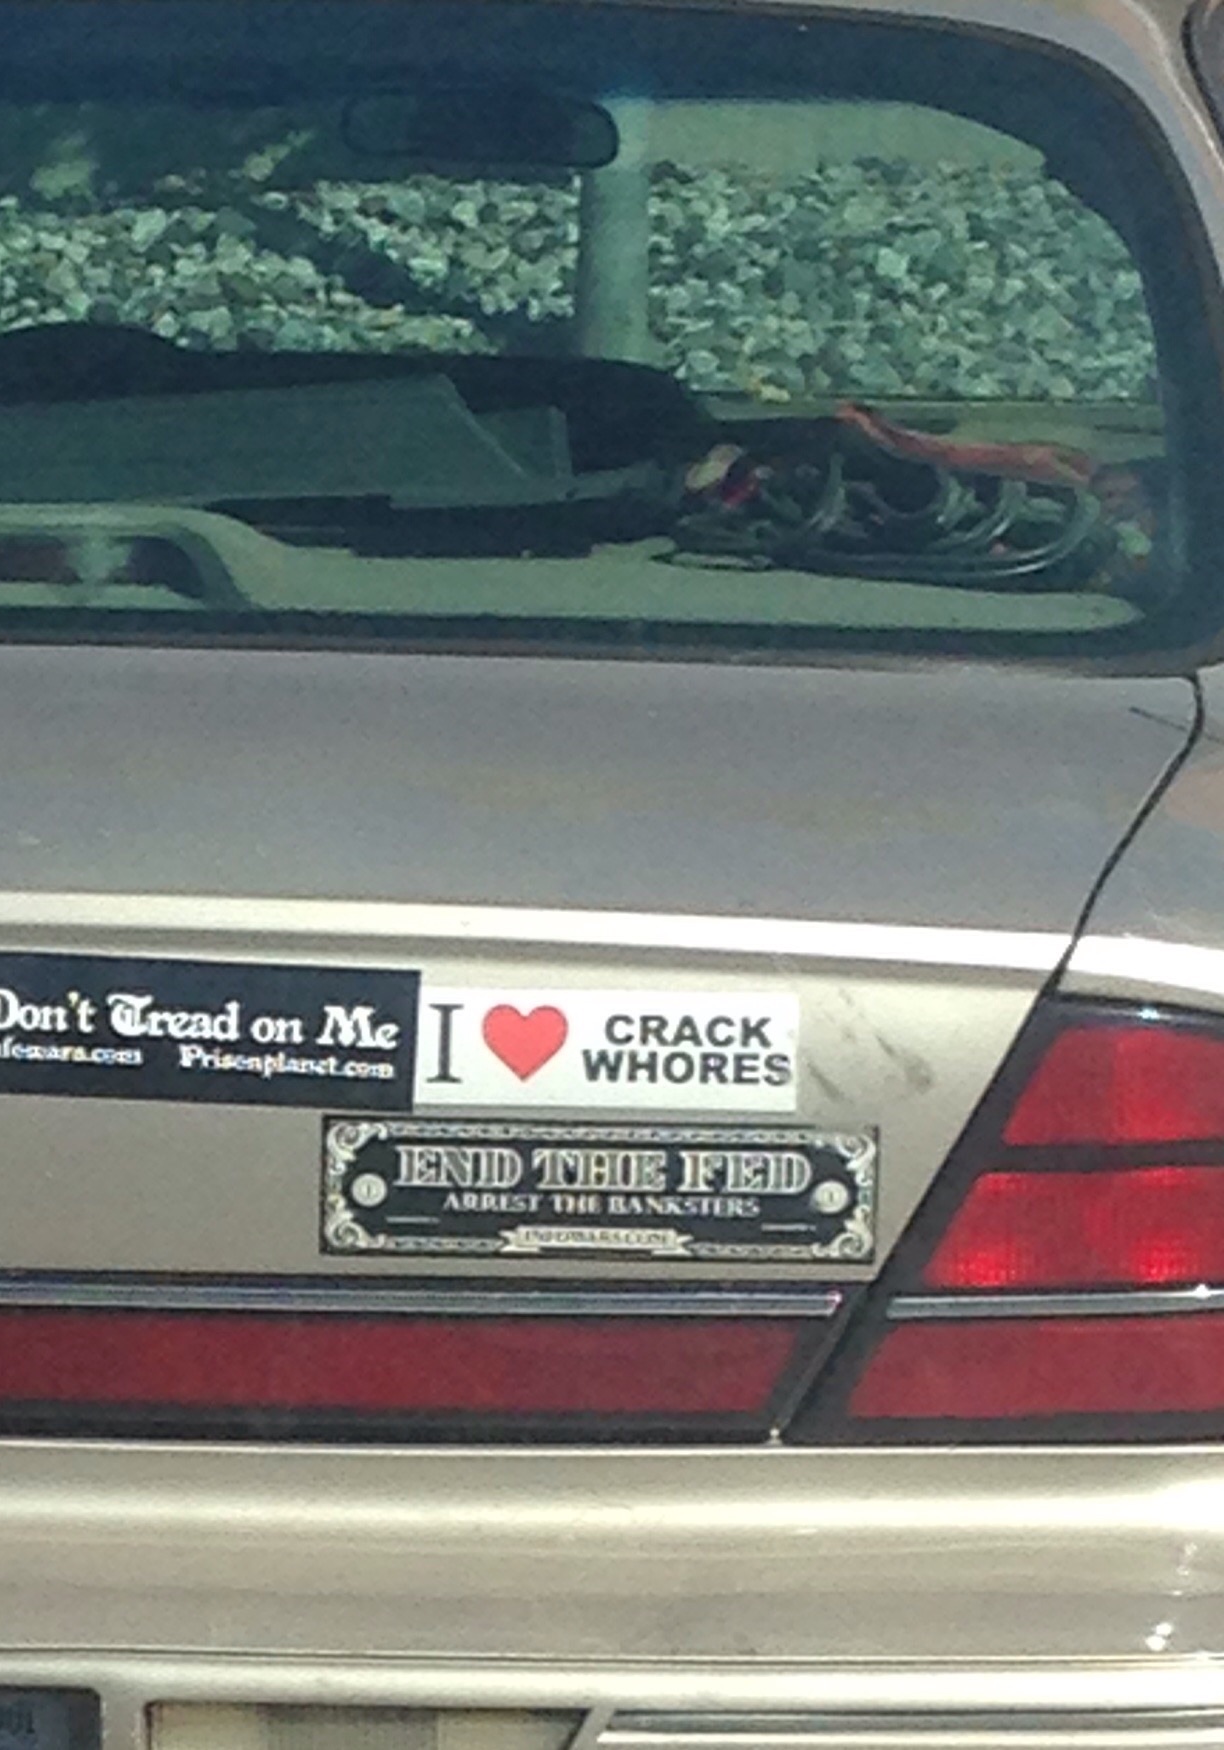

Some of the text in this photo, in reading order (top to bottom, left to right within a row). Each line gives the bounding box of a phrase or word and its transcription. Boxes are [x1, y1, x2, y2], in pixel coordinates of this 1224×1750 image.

[107, 994, 240, 1041] Tread
[250, 1012, 303, 1044] on
[316, 1004, 400, 1050] Me
[426, 1003, 464, 1085] I
[604, 1014, 772, 1049] CRACK
[581, 1049, 792, 1087] WHORES
[393, 1145, 814, 1197] END THE FED
[443, 1191, 761, 1218] ARREST THE BANKSTERS
